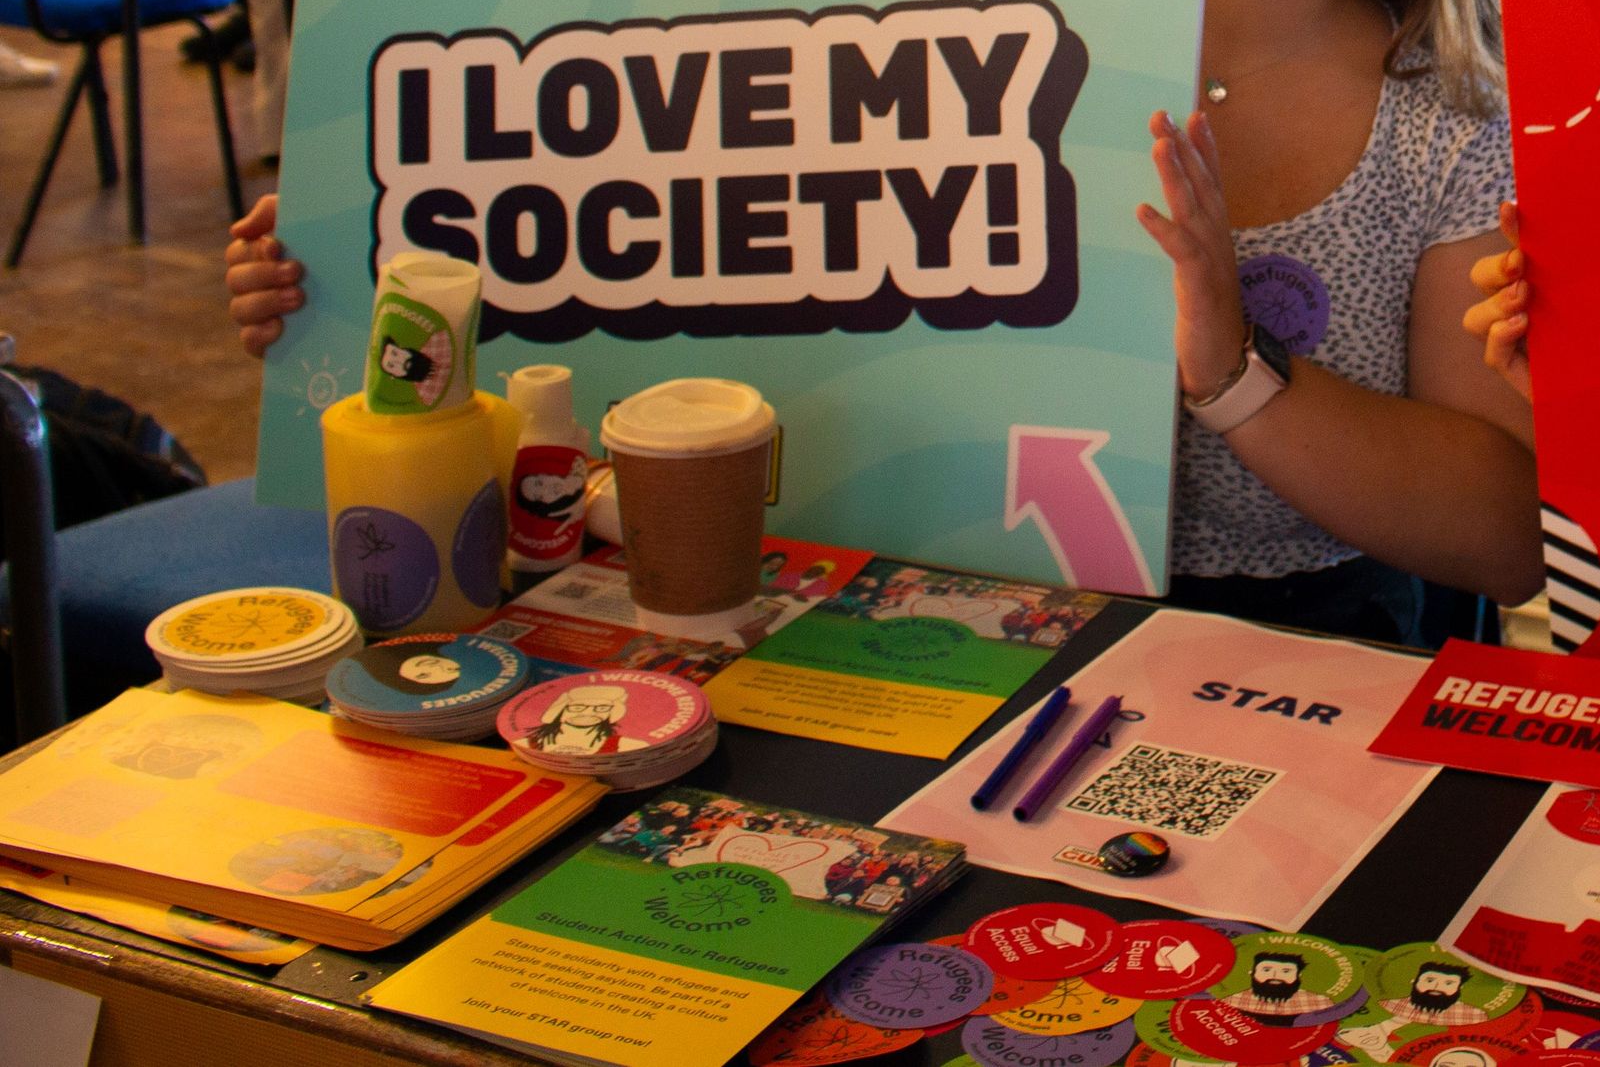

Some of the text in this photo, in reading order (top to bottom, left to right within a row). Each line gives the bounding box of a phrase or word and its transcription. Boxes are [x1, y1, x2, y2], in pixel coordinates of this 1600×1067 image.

[397, 33, 1031, 164] I LOVE MY
[401, 163, 1022, 285] SOCIETY!
[177, 612, 255, 650] Welcome
[239, 597, 315, 635] Refugees
[478, 640, 519, 675] WELCOME
[421, 673, 513, 710] REFUGEES
[599, 670, 690, 697] WELCOME
[648, 692, 697, 740] REFUGEES
[1192, 681, 1343, 727] STAR
[1062, 850, 1104, 867] GUI
[672, 866, 778, 905] Refugees
[644, 894, 752, 933] Welcome
[535, 912, 790, 976] Student Action for Refugees
[985, 927, 1021, 963] Access
[1009, 925, 1045, 955] Equal
[1126, 939, 1151, 971] Equal
[493, 950, 543, 968] people
[543, 959, 595, 982] seeking
[596, 973, 648, 992] asylum.
[649, 985, 670, 998] Be
[670, 991, 704, 1010] part
[704, 996, 723, 1008] of
[506, 938, 751, 1000] Stand in solidarity with refugees and
[898, 948, 974, 1004] Refugees
[1267, 935, 1342, 963] WELCOME
[1326, 956, 1354, 997] REFUGEES
[471, 956, 526, 977] network
[527, 968, 545, 980] of
[546, 974, 607, 996] students
[607, 989, 665, 1011] creating
[677, 1008, 729, 1024] culture
[510, 980, 656, 1021] of welcome in the UK.
[849, 964, 924, 1018] Welcome
[461, 996, 653, 1048] Join your STAR group now!
[1190, 1008, 1240, 1048] Access
[981, 1025, 1085, 1067] Welcome
[1397, 1034, 1455, 1064] ELCOME
